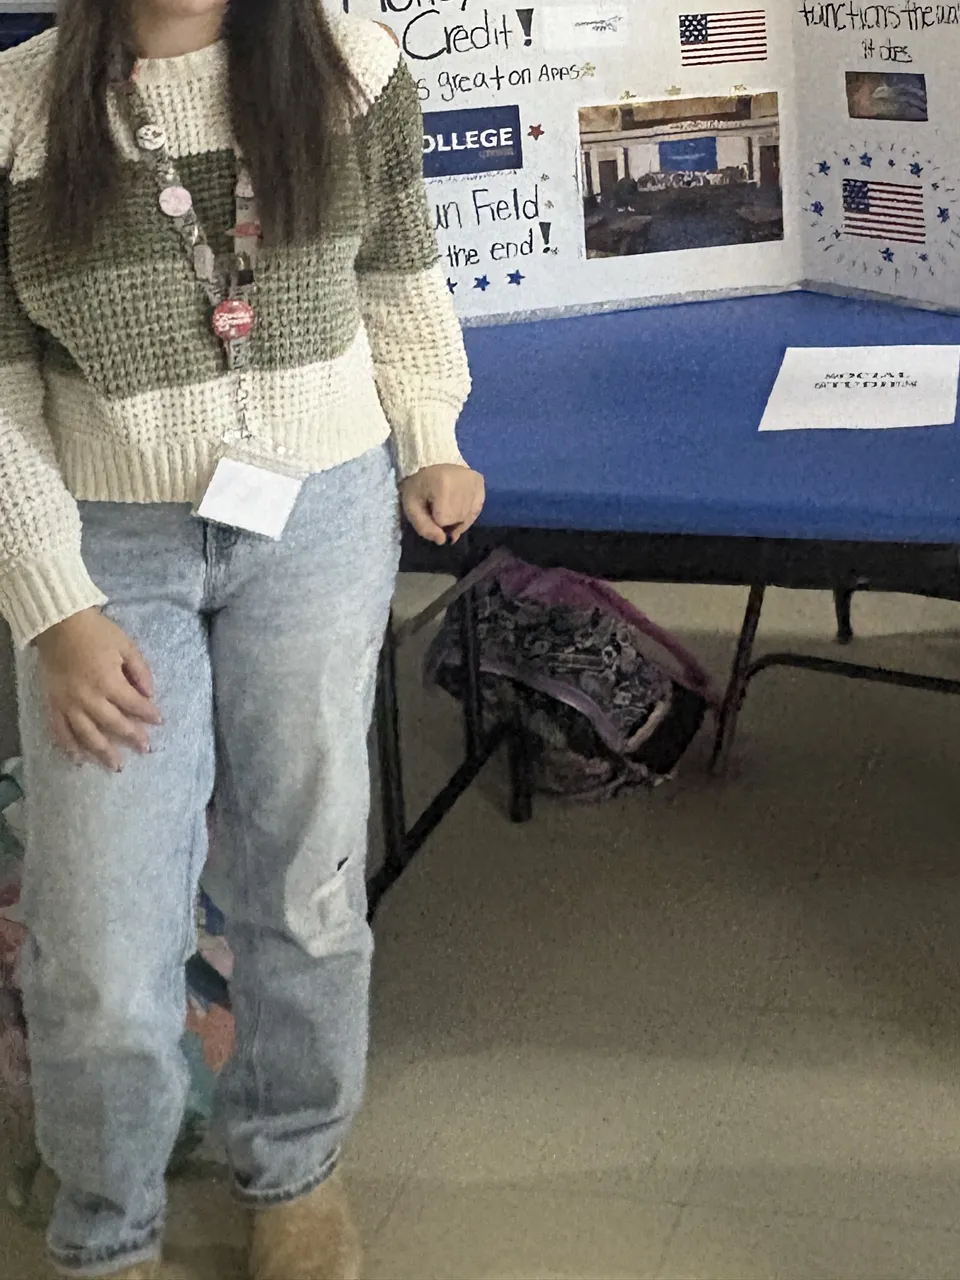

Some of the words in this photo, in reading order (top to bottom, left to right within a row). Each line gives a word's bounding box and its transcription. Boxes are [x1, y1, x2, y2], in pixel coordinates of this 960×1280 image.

[402, 7, 536, 60] Credit!
[422, 127, 514, 154] OLLEGE
[473, 183, 540, 226] Field
